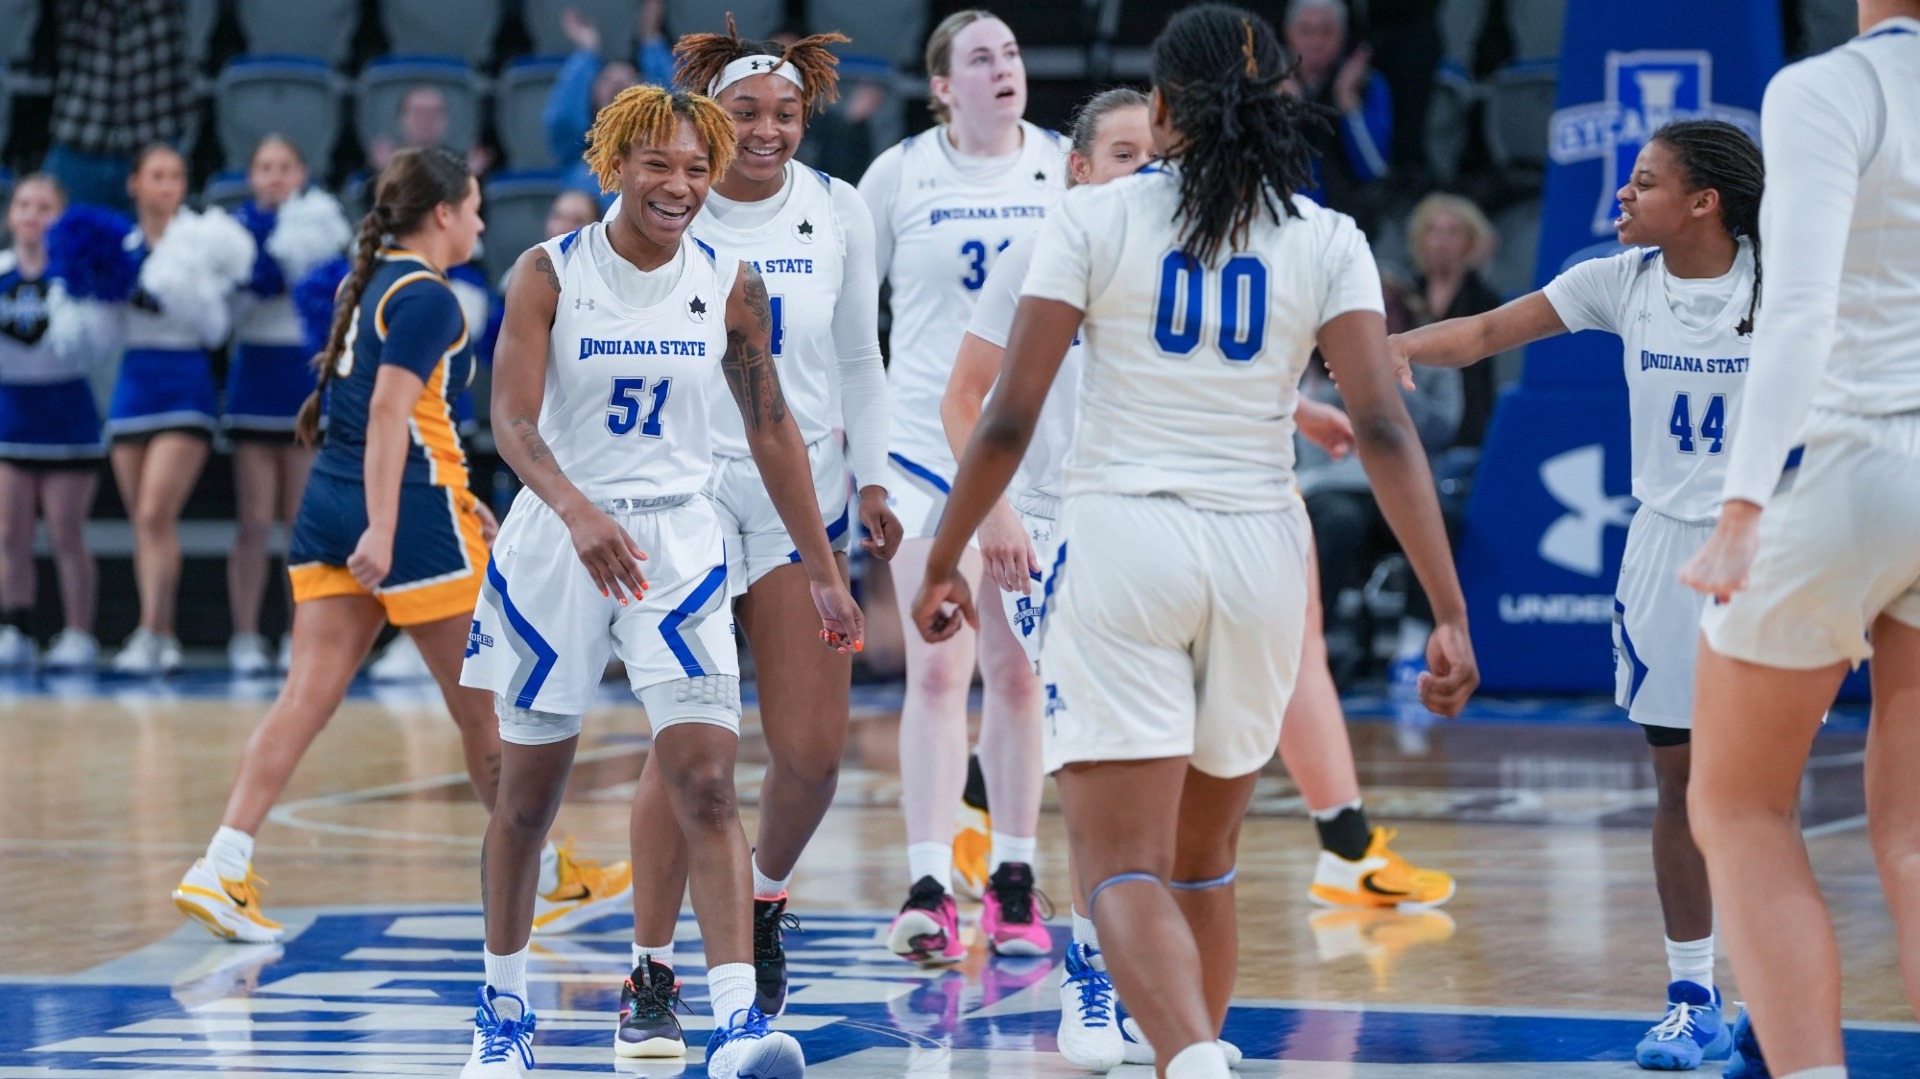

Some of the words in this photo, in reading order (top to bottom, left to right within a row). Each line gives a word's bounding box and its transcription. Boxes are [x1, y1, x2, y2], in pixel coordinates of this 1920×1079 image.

[1001, 205, 1046, 219] STATE
[765, 258, 813, 274] STATE
[1149, 243, 1273, 367] 00
[579, 337, 657, 361] INDIANA
[660, 340, 706, 357] STATE
[1641, 350, 1704, 372] INDIANA
[605, 376, 673, 439] 51
[1668, 391, 1727, 456] 44
